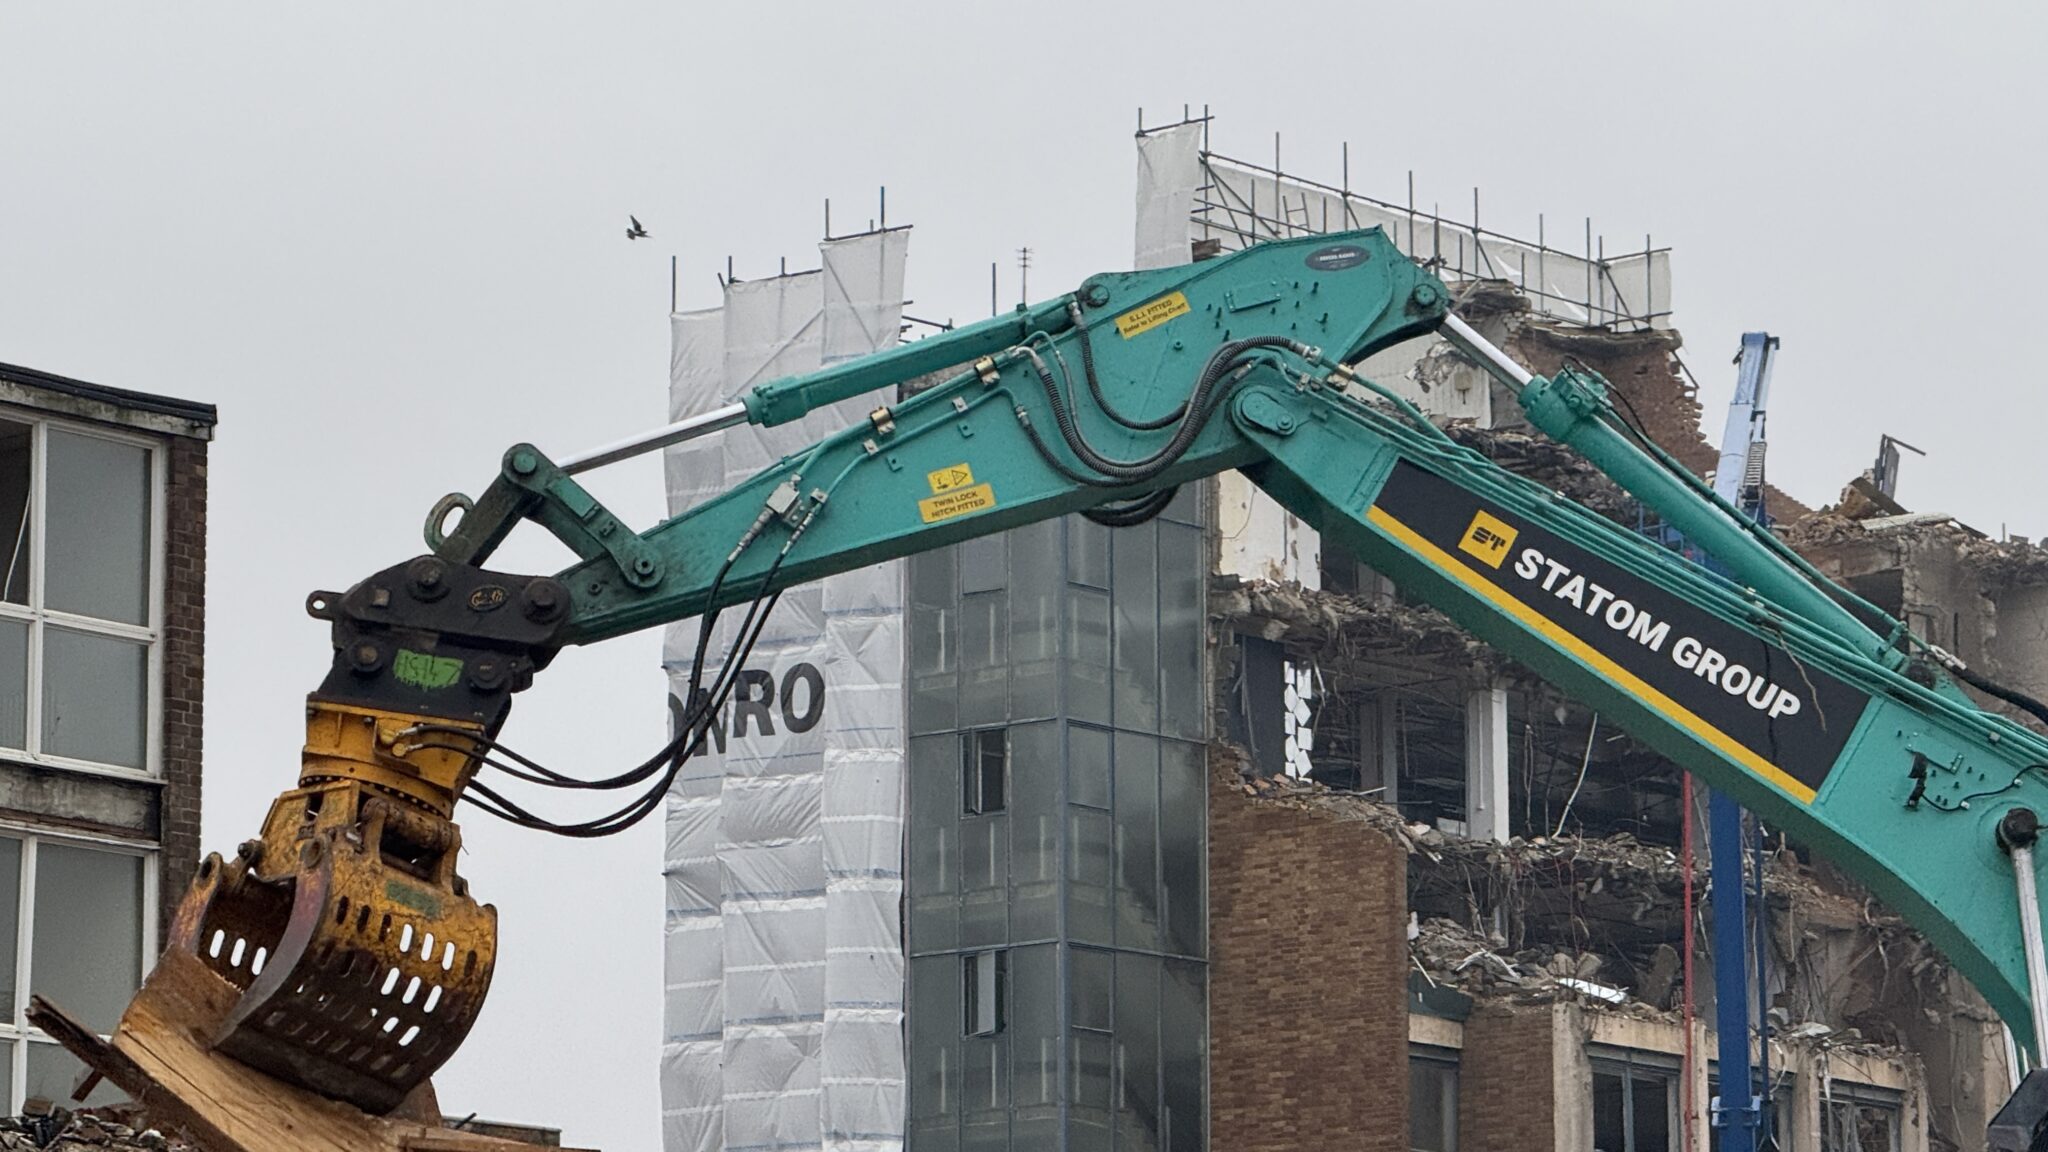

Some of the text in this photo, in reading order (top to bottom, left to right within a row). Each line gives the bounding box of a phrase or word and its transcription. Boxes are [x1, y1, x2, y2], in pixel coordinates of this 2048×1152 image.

[931, 498, 986, 518] HITCH FITTED
[933, 490, 978, 508] TWIN LOCK
[1514, 548, 1801, 719] STATOM GROUP
